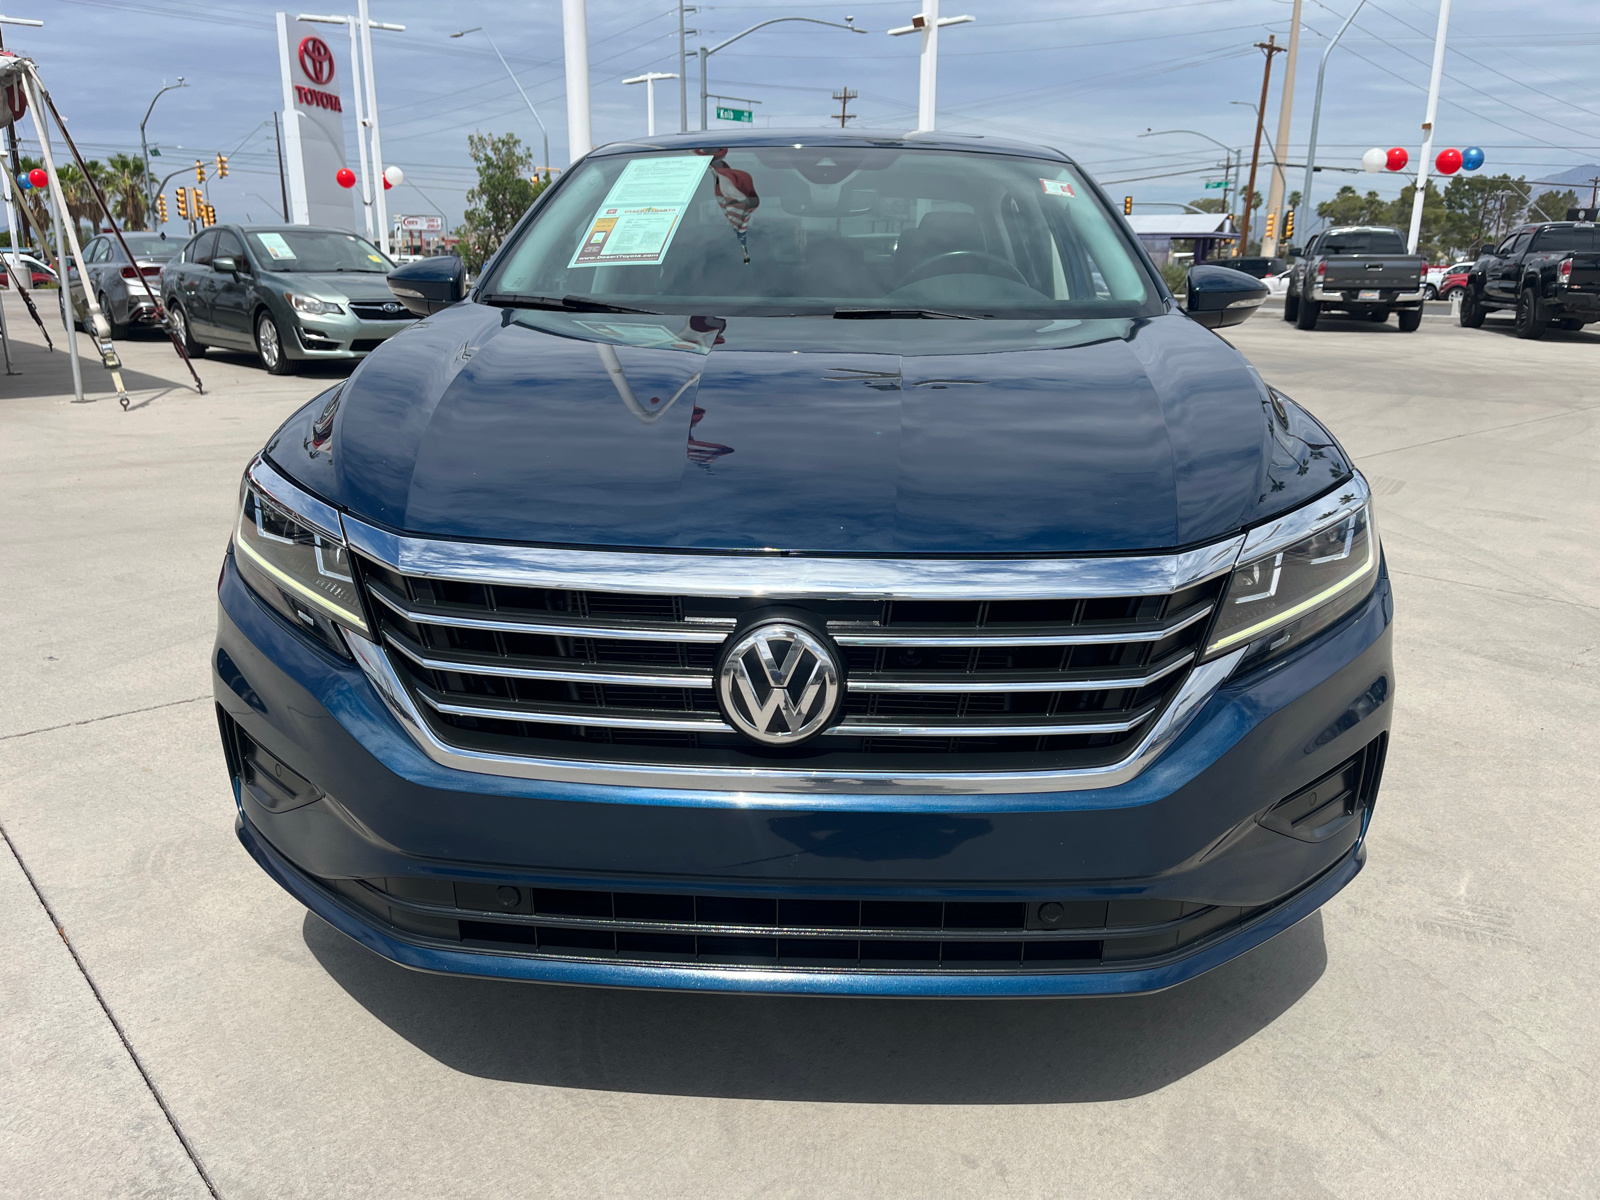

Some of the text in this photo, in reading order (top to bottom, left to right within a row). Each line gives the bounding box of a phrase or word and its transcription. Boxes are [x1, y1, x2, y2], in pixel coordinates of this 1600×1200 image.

[295, 85, 342, 113] TOYOTA
[720, 109, 734, 120] Kolb
[578, 253, 659, 261] www.DesertToyota.com
